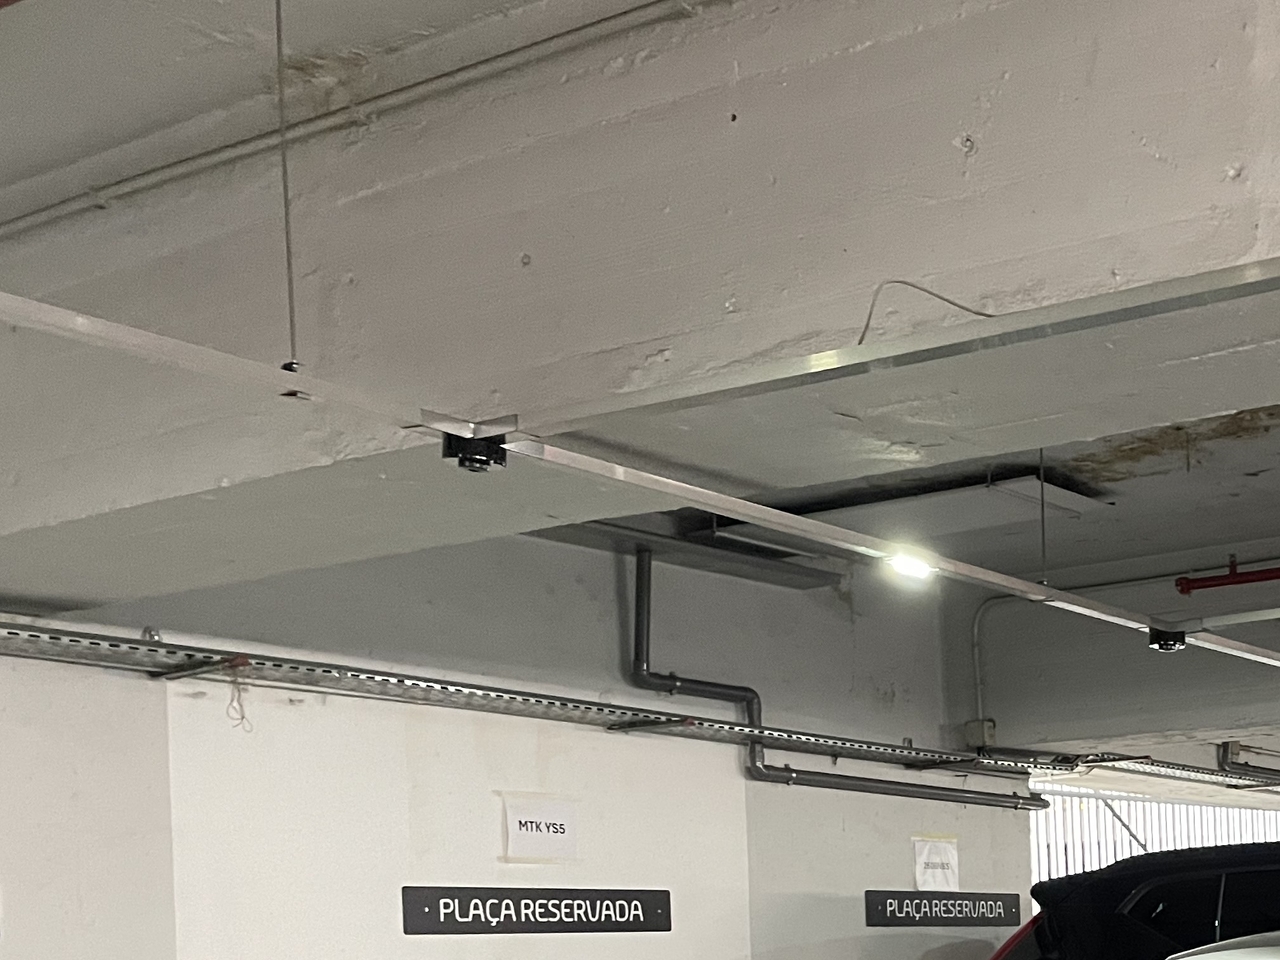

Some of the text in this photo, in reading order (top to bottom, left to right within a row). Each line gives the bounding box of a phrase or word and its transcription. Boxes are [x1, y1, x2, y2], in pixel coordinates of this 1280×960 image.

[518, 819, 566, 835] MTK YS5
[439, 898, 644, 927] PLAÇA RESERVADA
[886, 898, 1005, 921] PLAÇA RESERVADA
